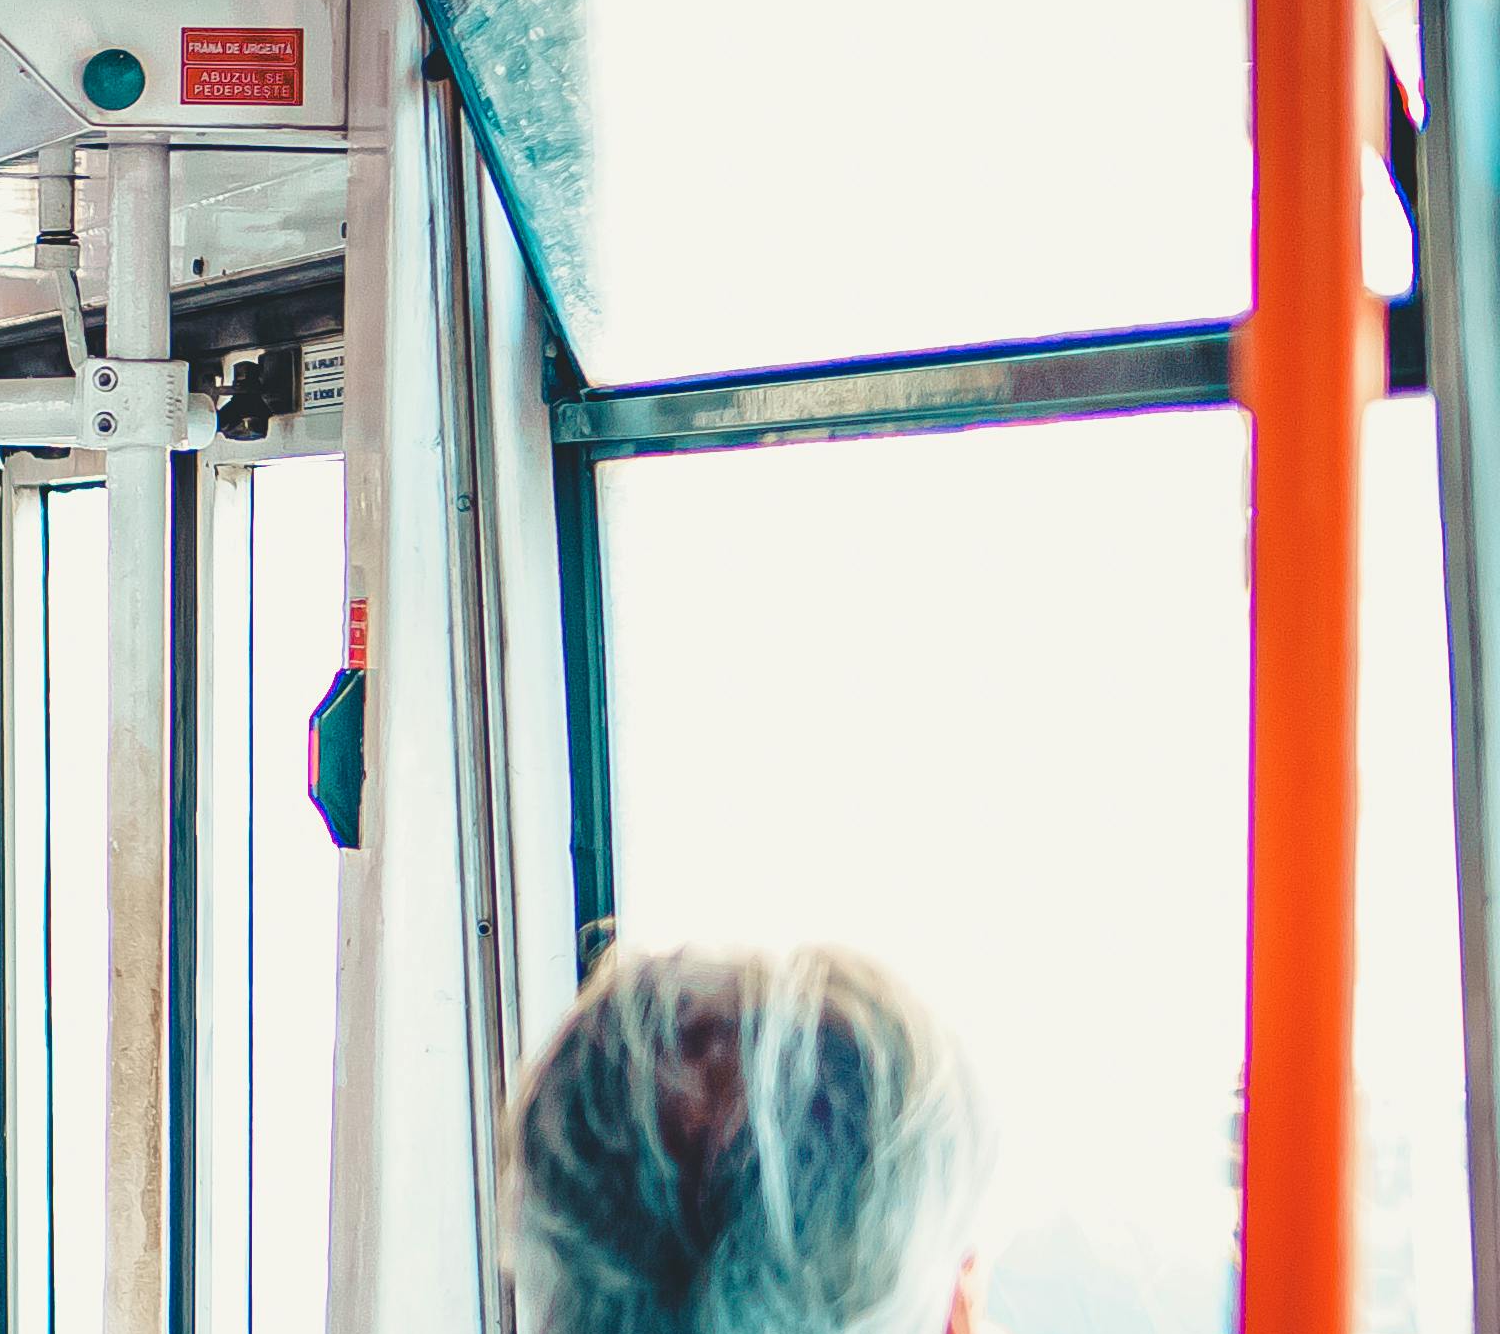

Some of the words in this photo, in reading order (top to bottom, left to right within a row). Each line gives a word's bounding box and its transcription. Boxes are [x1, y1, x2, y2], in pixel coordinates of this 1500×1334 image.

[225, 43, 240, 54] DE
[200, 71, 259, 83] ABUZUL
[265, 73, 284, 83] SE
